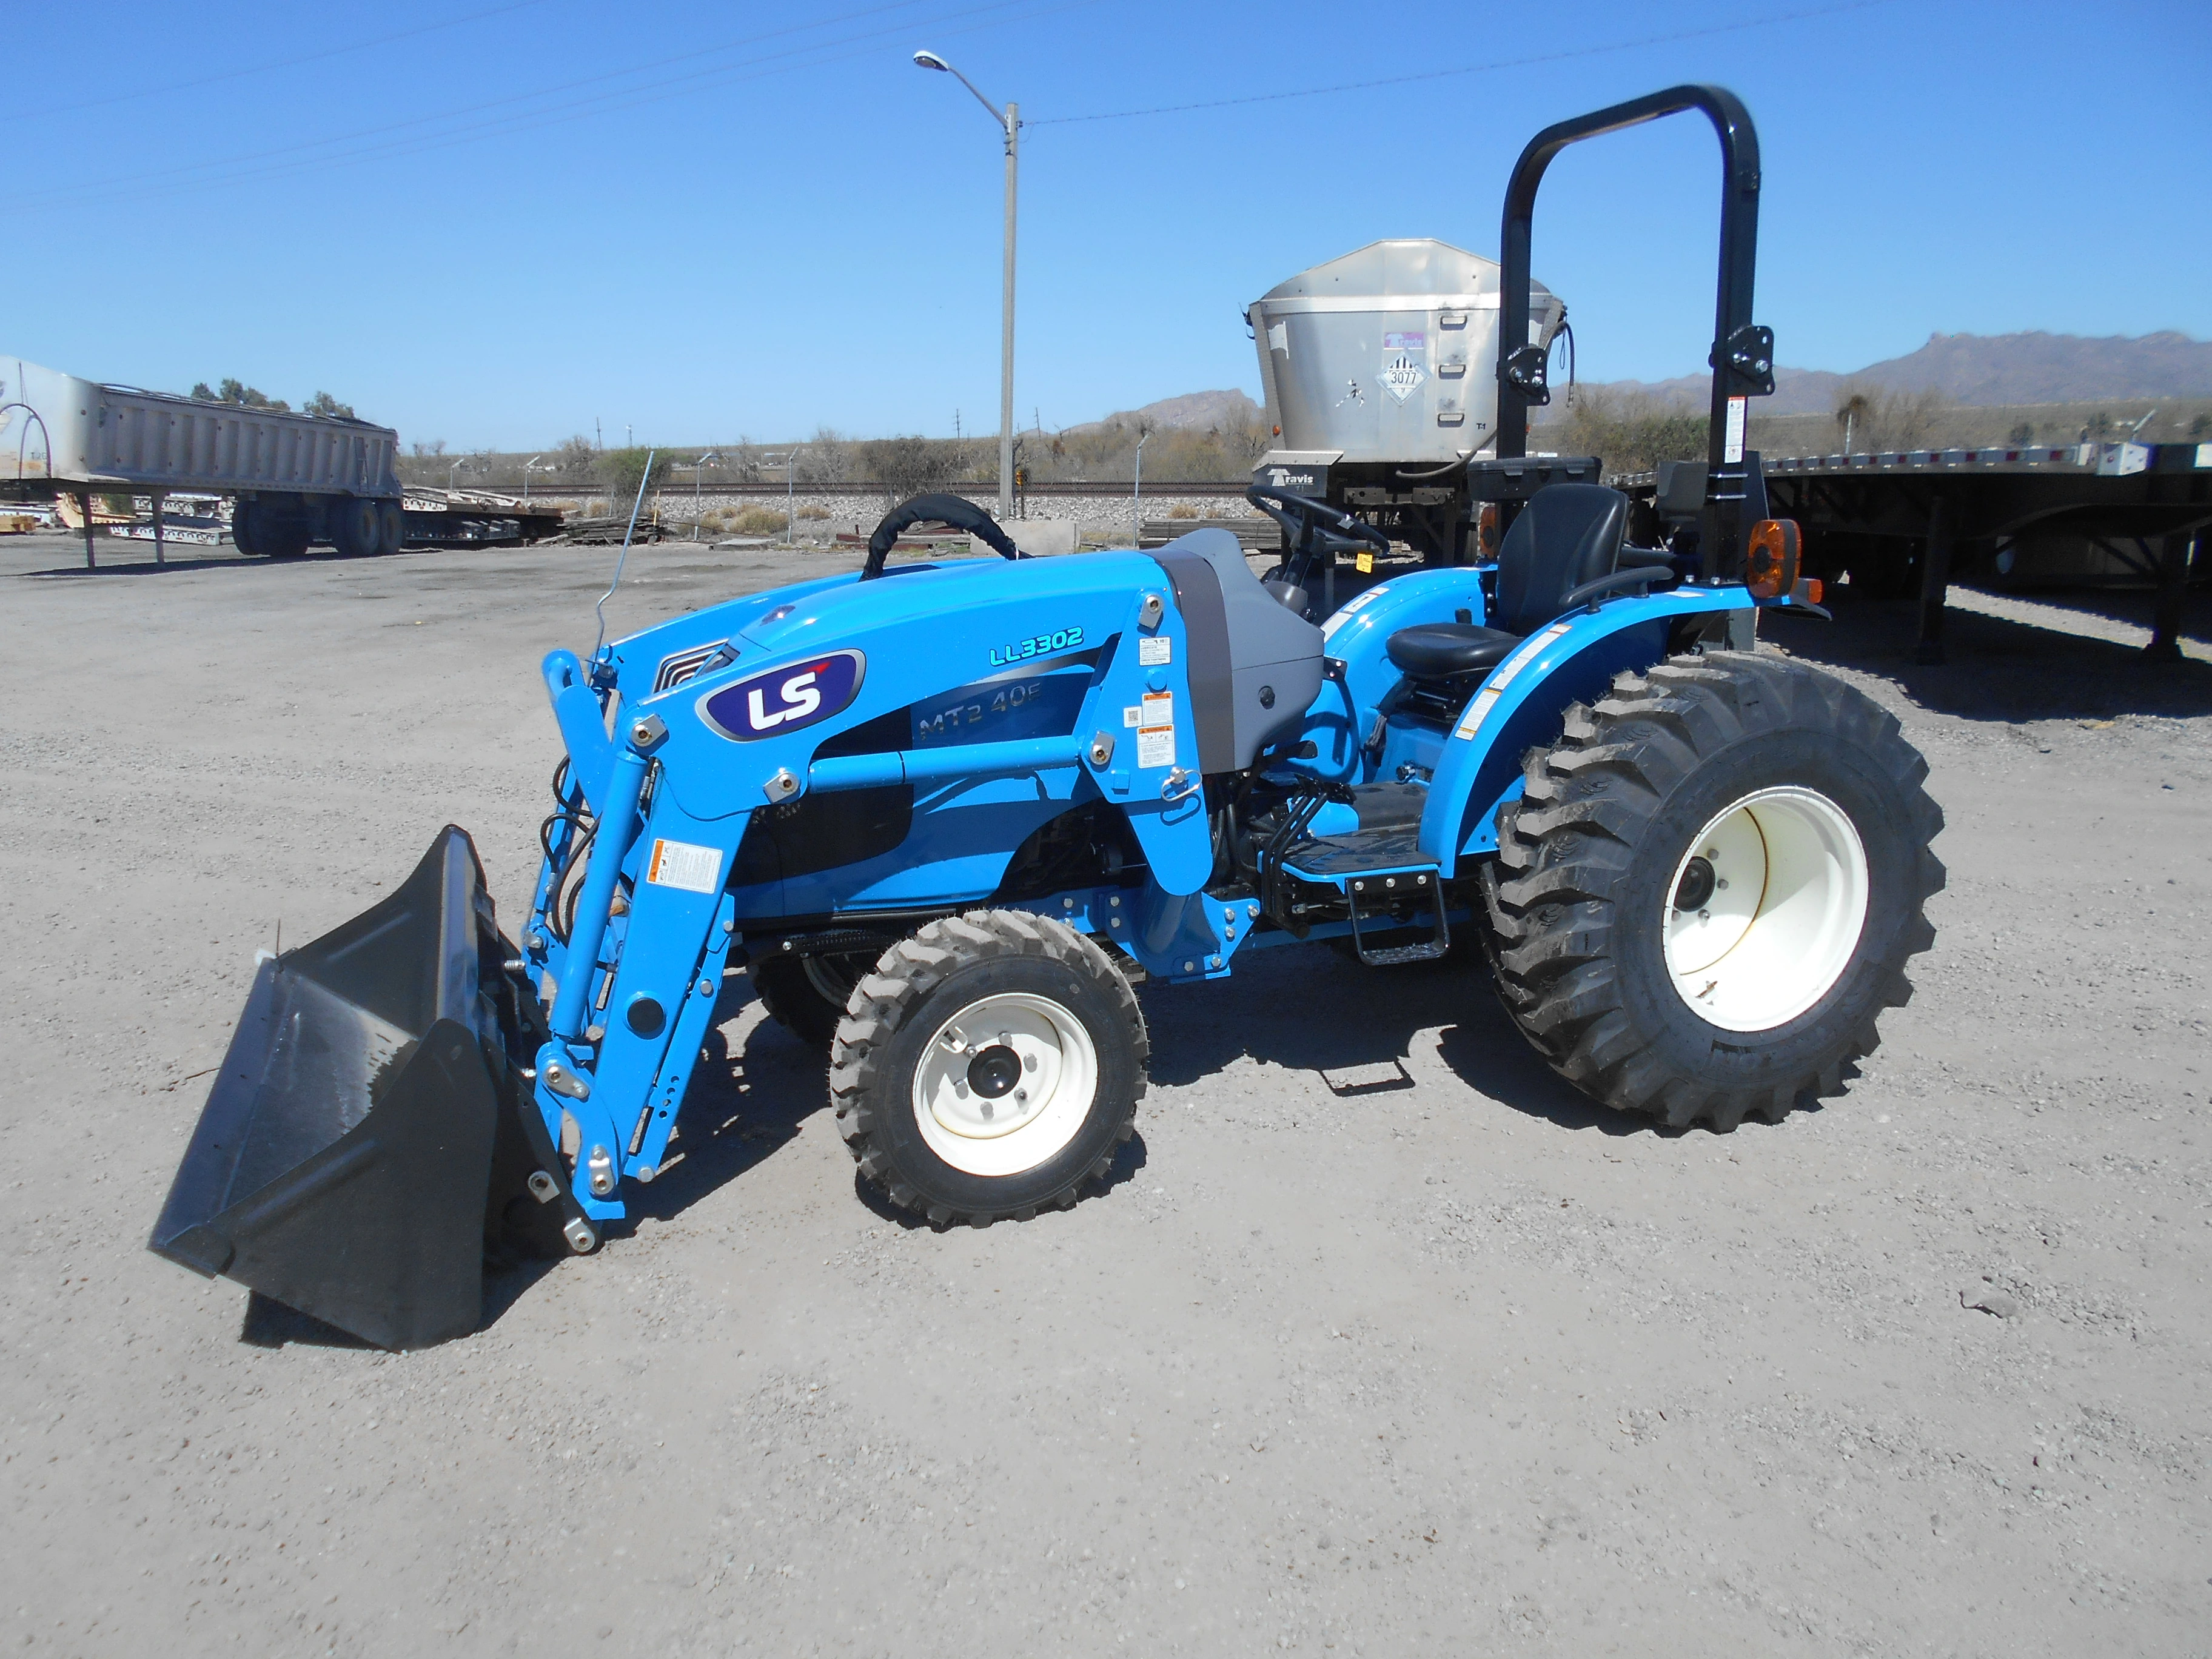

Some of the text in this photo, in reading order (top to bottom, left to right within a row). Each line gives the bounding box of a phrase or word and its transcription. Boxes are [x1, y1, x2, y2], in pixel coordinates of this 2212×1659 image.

[1391, 372, 1417, 384] 3077
[1267, 469, 1313, 486] Travis
[990, 626, 1084, 666] LL3302
[748, 671, 821, 731] LS
[920, 705, 982, 740] MT2
